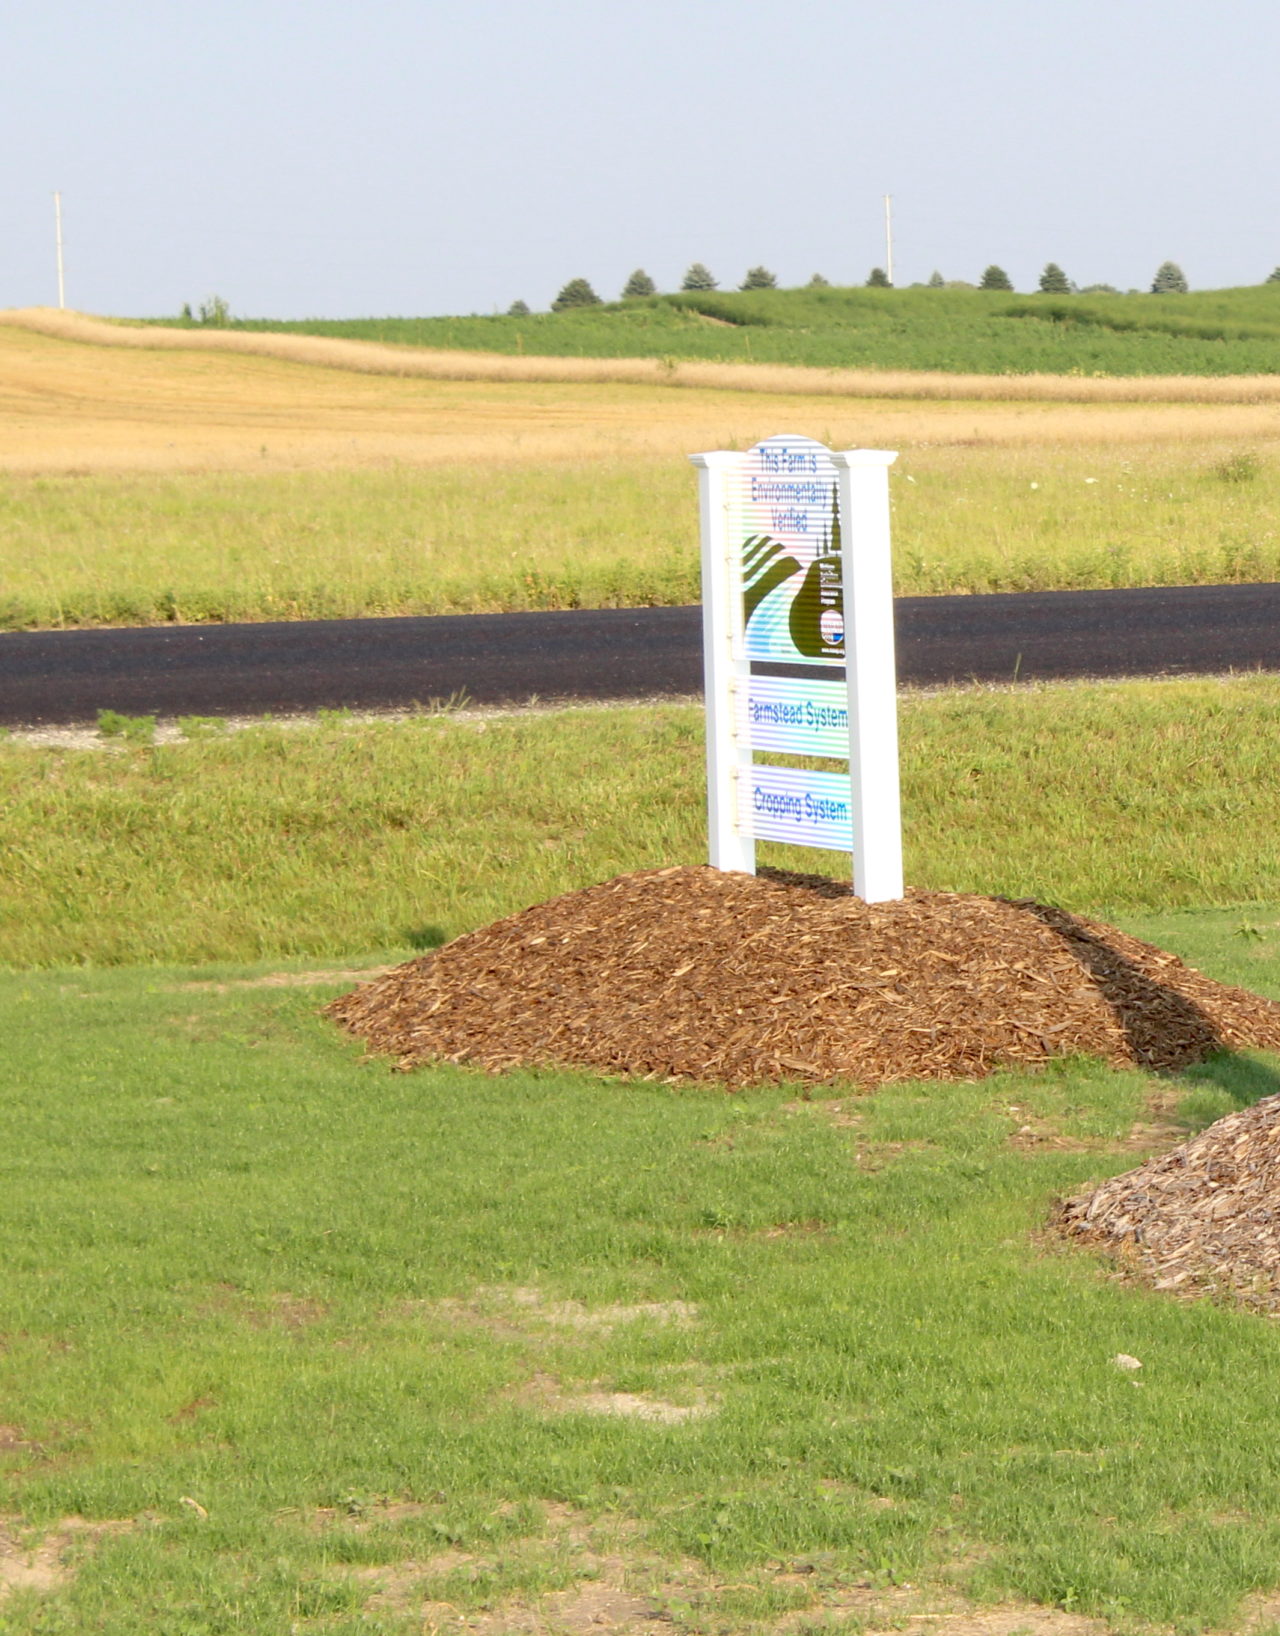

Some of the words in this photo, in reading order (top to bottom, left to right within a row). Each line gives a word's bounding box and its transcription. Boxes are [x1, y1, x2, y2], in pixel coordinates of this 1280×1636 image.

[759, 448, 778, 473] This
[782, 448, 806, 473] Farm
[751, 477, 828, 509] Environmentally
[770, 507, 808, 532] Verified
[748, 698, 803, 724] Farmstead
[807, 701, 849, 732] System
[754, 787, 801, 822] Cropping
[805, 793, 848, 825] System
